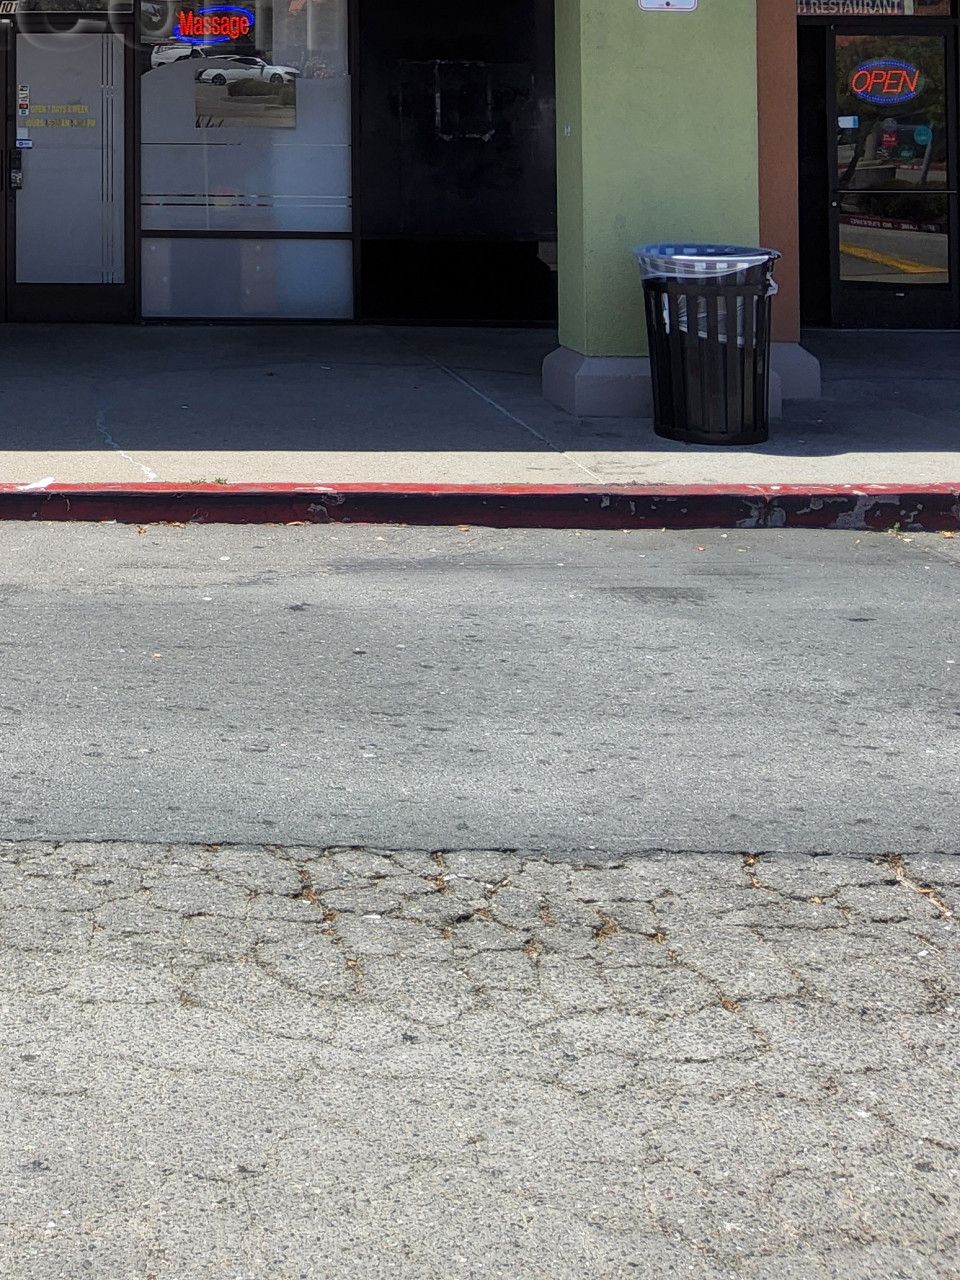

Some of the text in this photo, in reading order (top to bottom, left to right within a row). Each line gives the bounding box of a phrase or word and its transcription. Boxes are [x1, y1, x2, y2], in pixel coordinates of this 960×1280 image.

[809, 0, 900, 14] RESTAURANT
[178, 10, 250, 39] Massage
[851, 69, 920, 93] OPEN
